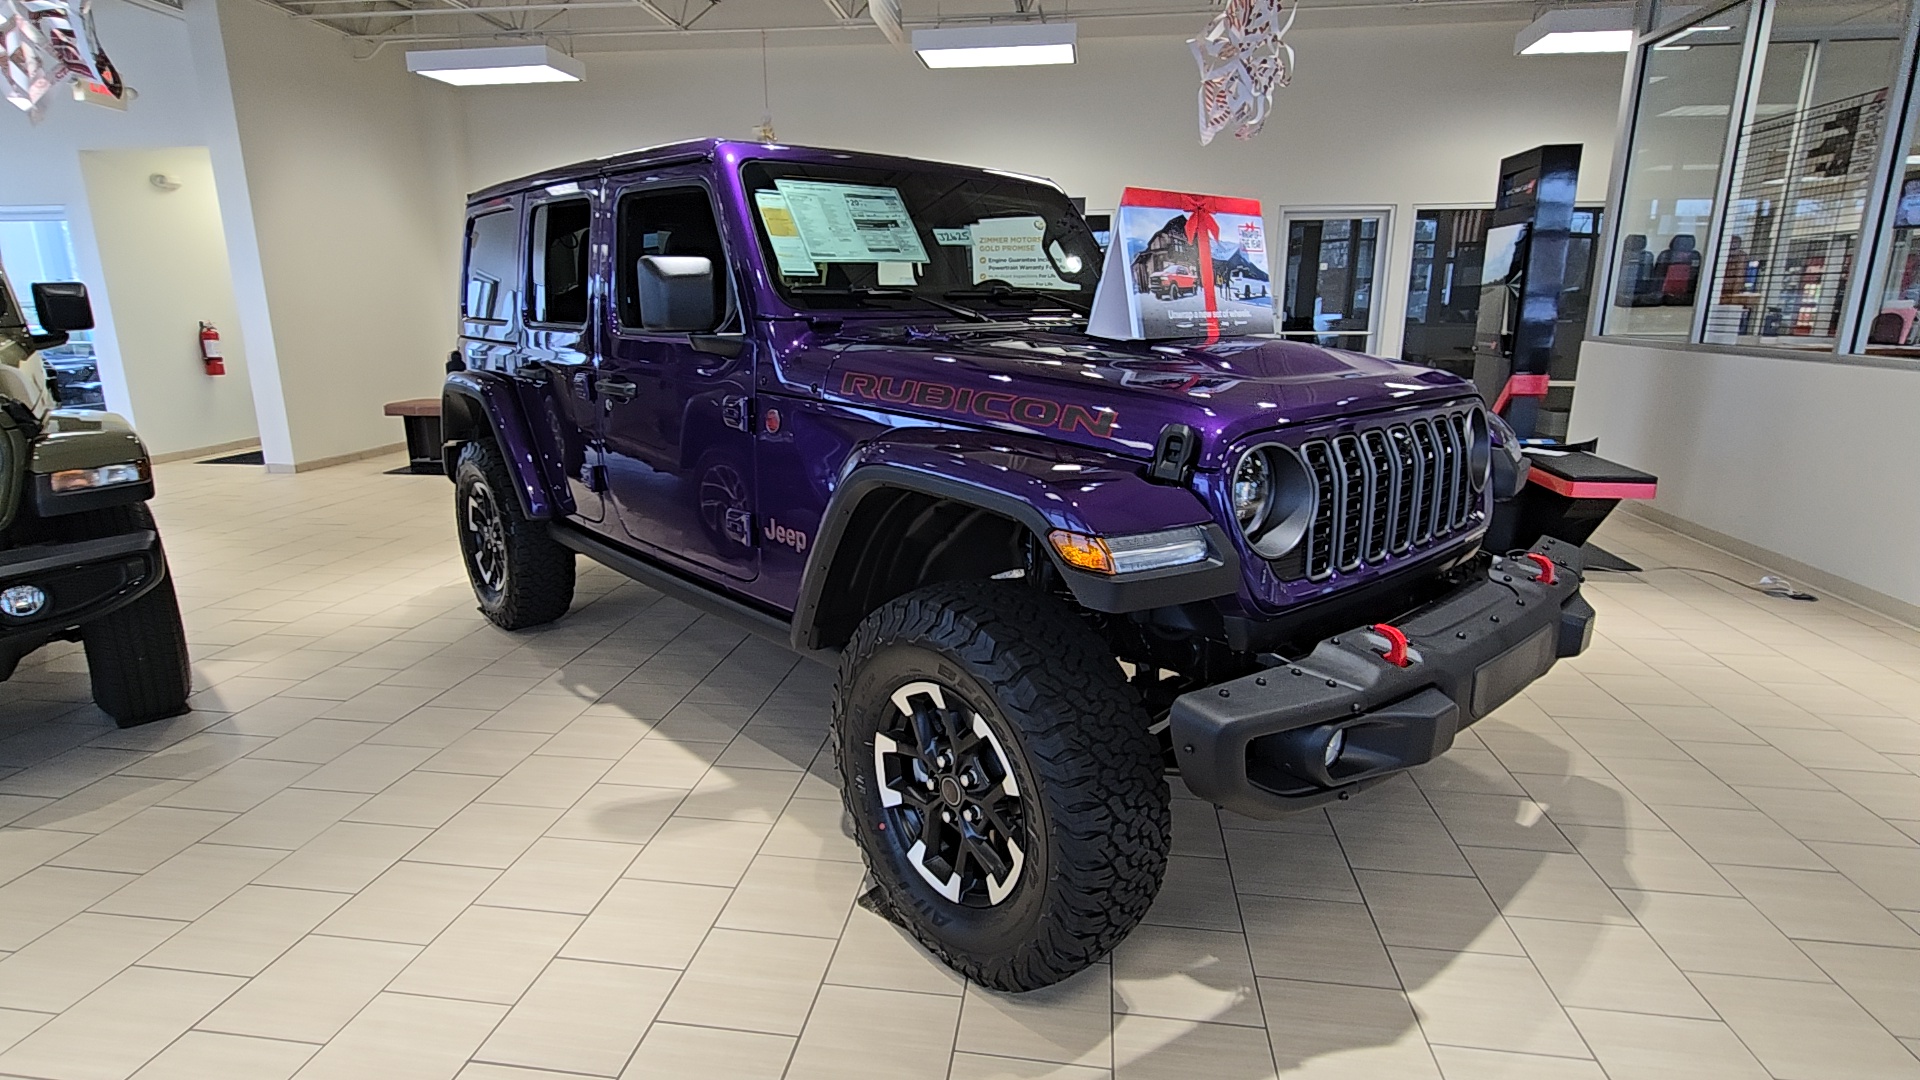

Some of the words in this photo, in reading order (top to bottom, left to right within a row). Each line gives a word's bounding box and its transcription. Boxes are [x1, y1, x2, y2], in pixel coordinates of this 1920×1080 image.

[979, 236, 1009, 244] ZIMMER
[1002, 244, 1036, 252] PROMISE
[840, 371, 1119, 438] RUBICON
[764, 517, 807, 554] Jeep
